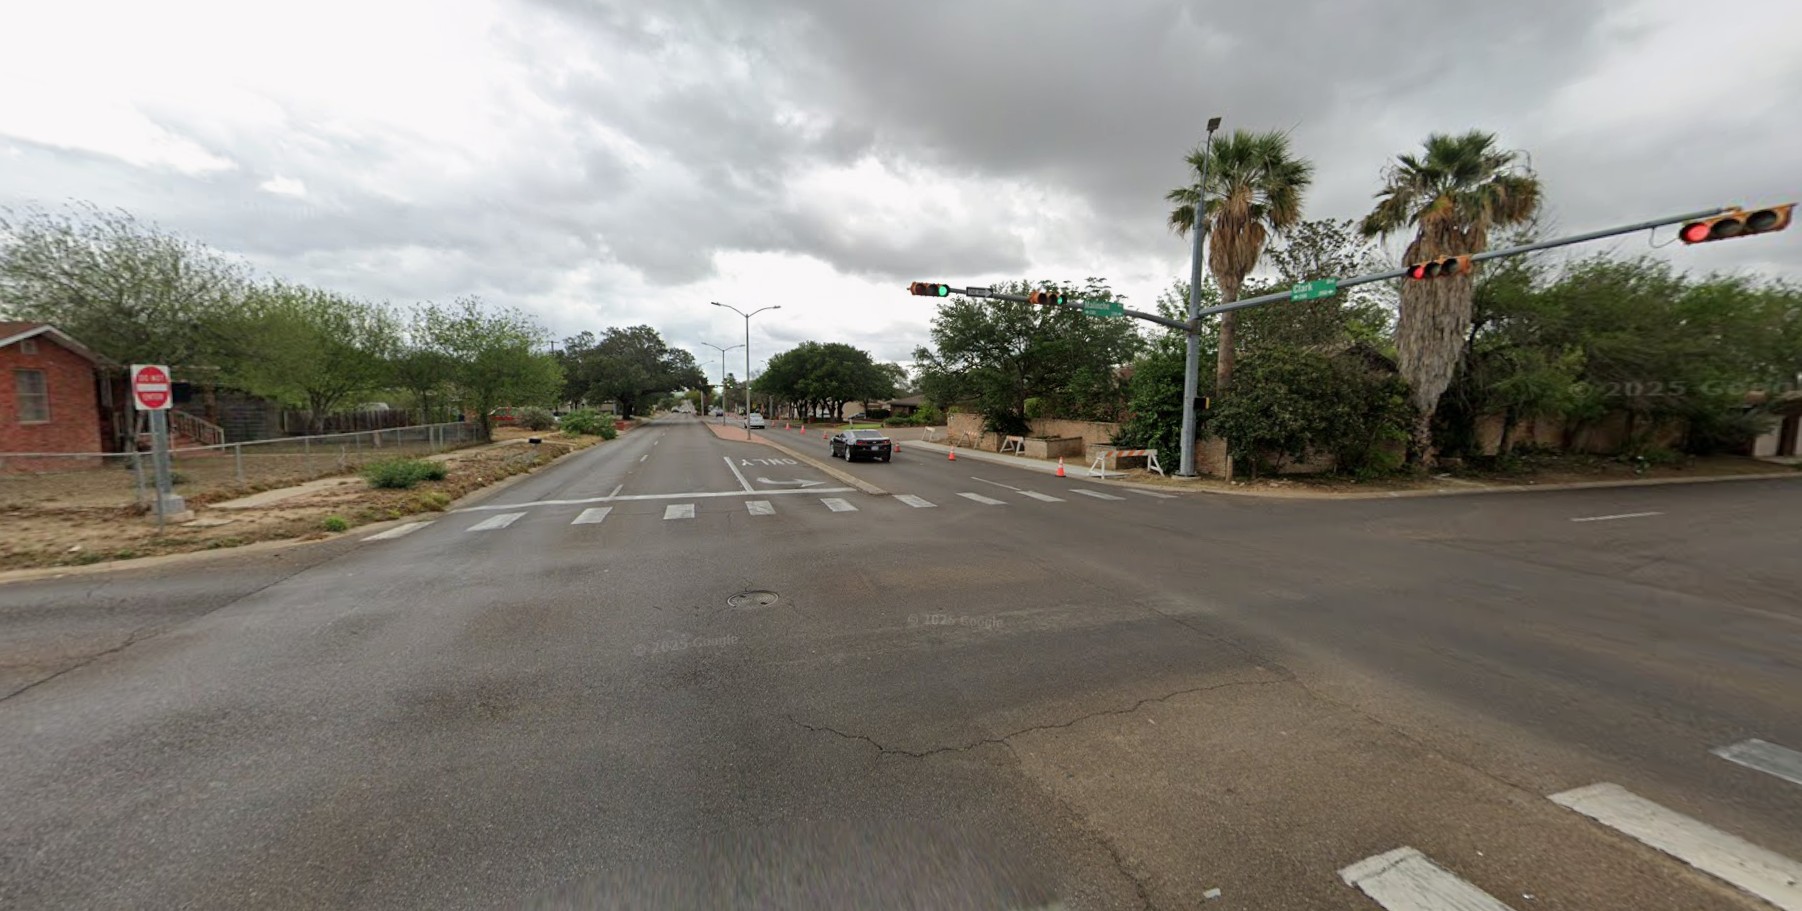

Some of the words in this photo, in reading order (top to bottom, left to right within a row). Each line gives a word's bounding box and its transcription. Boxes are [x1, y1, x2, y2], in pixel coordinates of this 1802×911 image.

[1292, 282, 1314, 294] Clark
[137, 374, 149, 382] DO
[151, 374, 165, 382] NOT
[741, 458, 798, 467] ONLY
